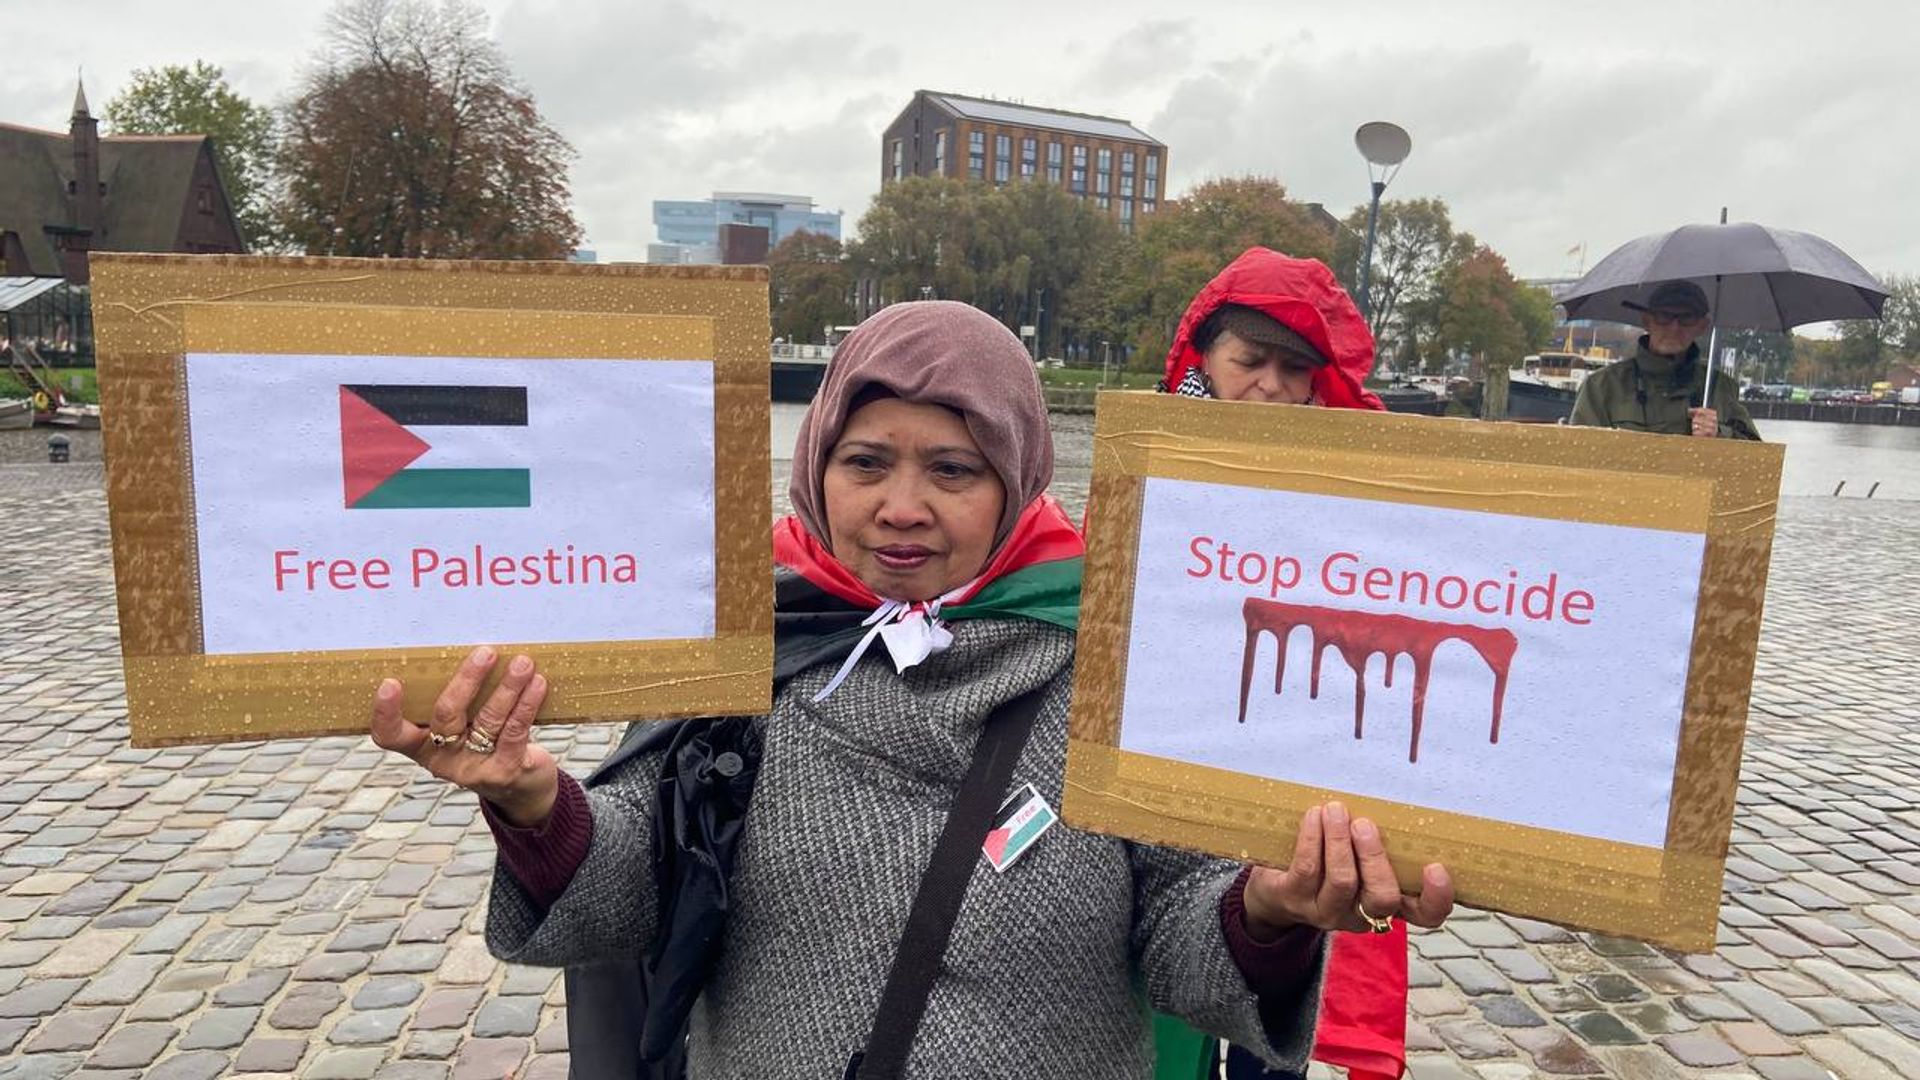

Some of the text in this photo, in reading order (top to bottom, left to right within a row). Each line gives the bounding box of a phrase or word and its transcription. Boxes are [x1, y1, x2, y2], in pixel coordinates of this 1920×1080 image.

[274, 544, 637, 591] Free Palestina
[1187, 536, 1596, 625] Stop Genocide
